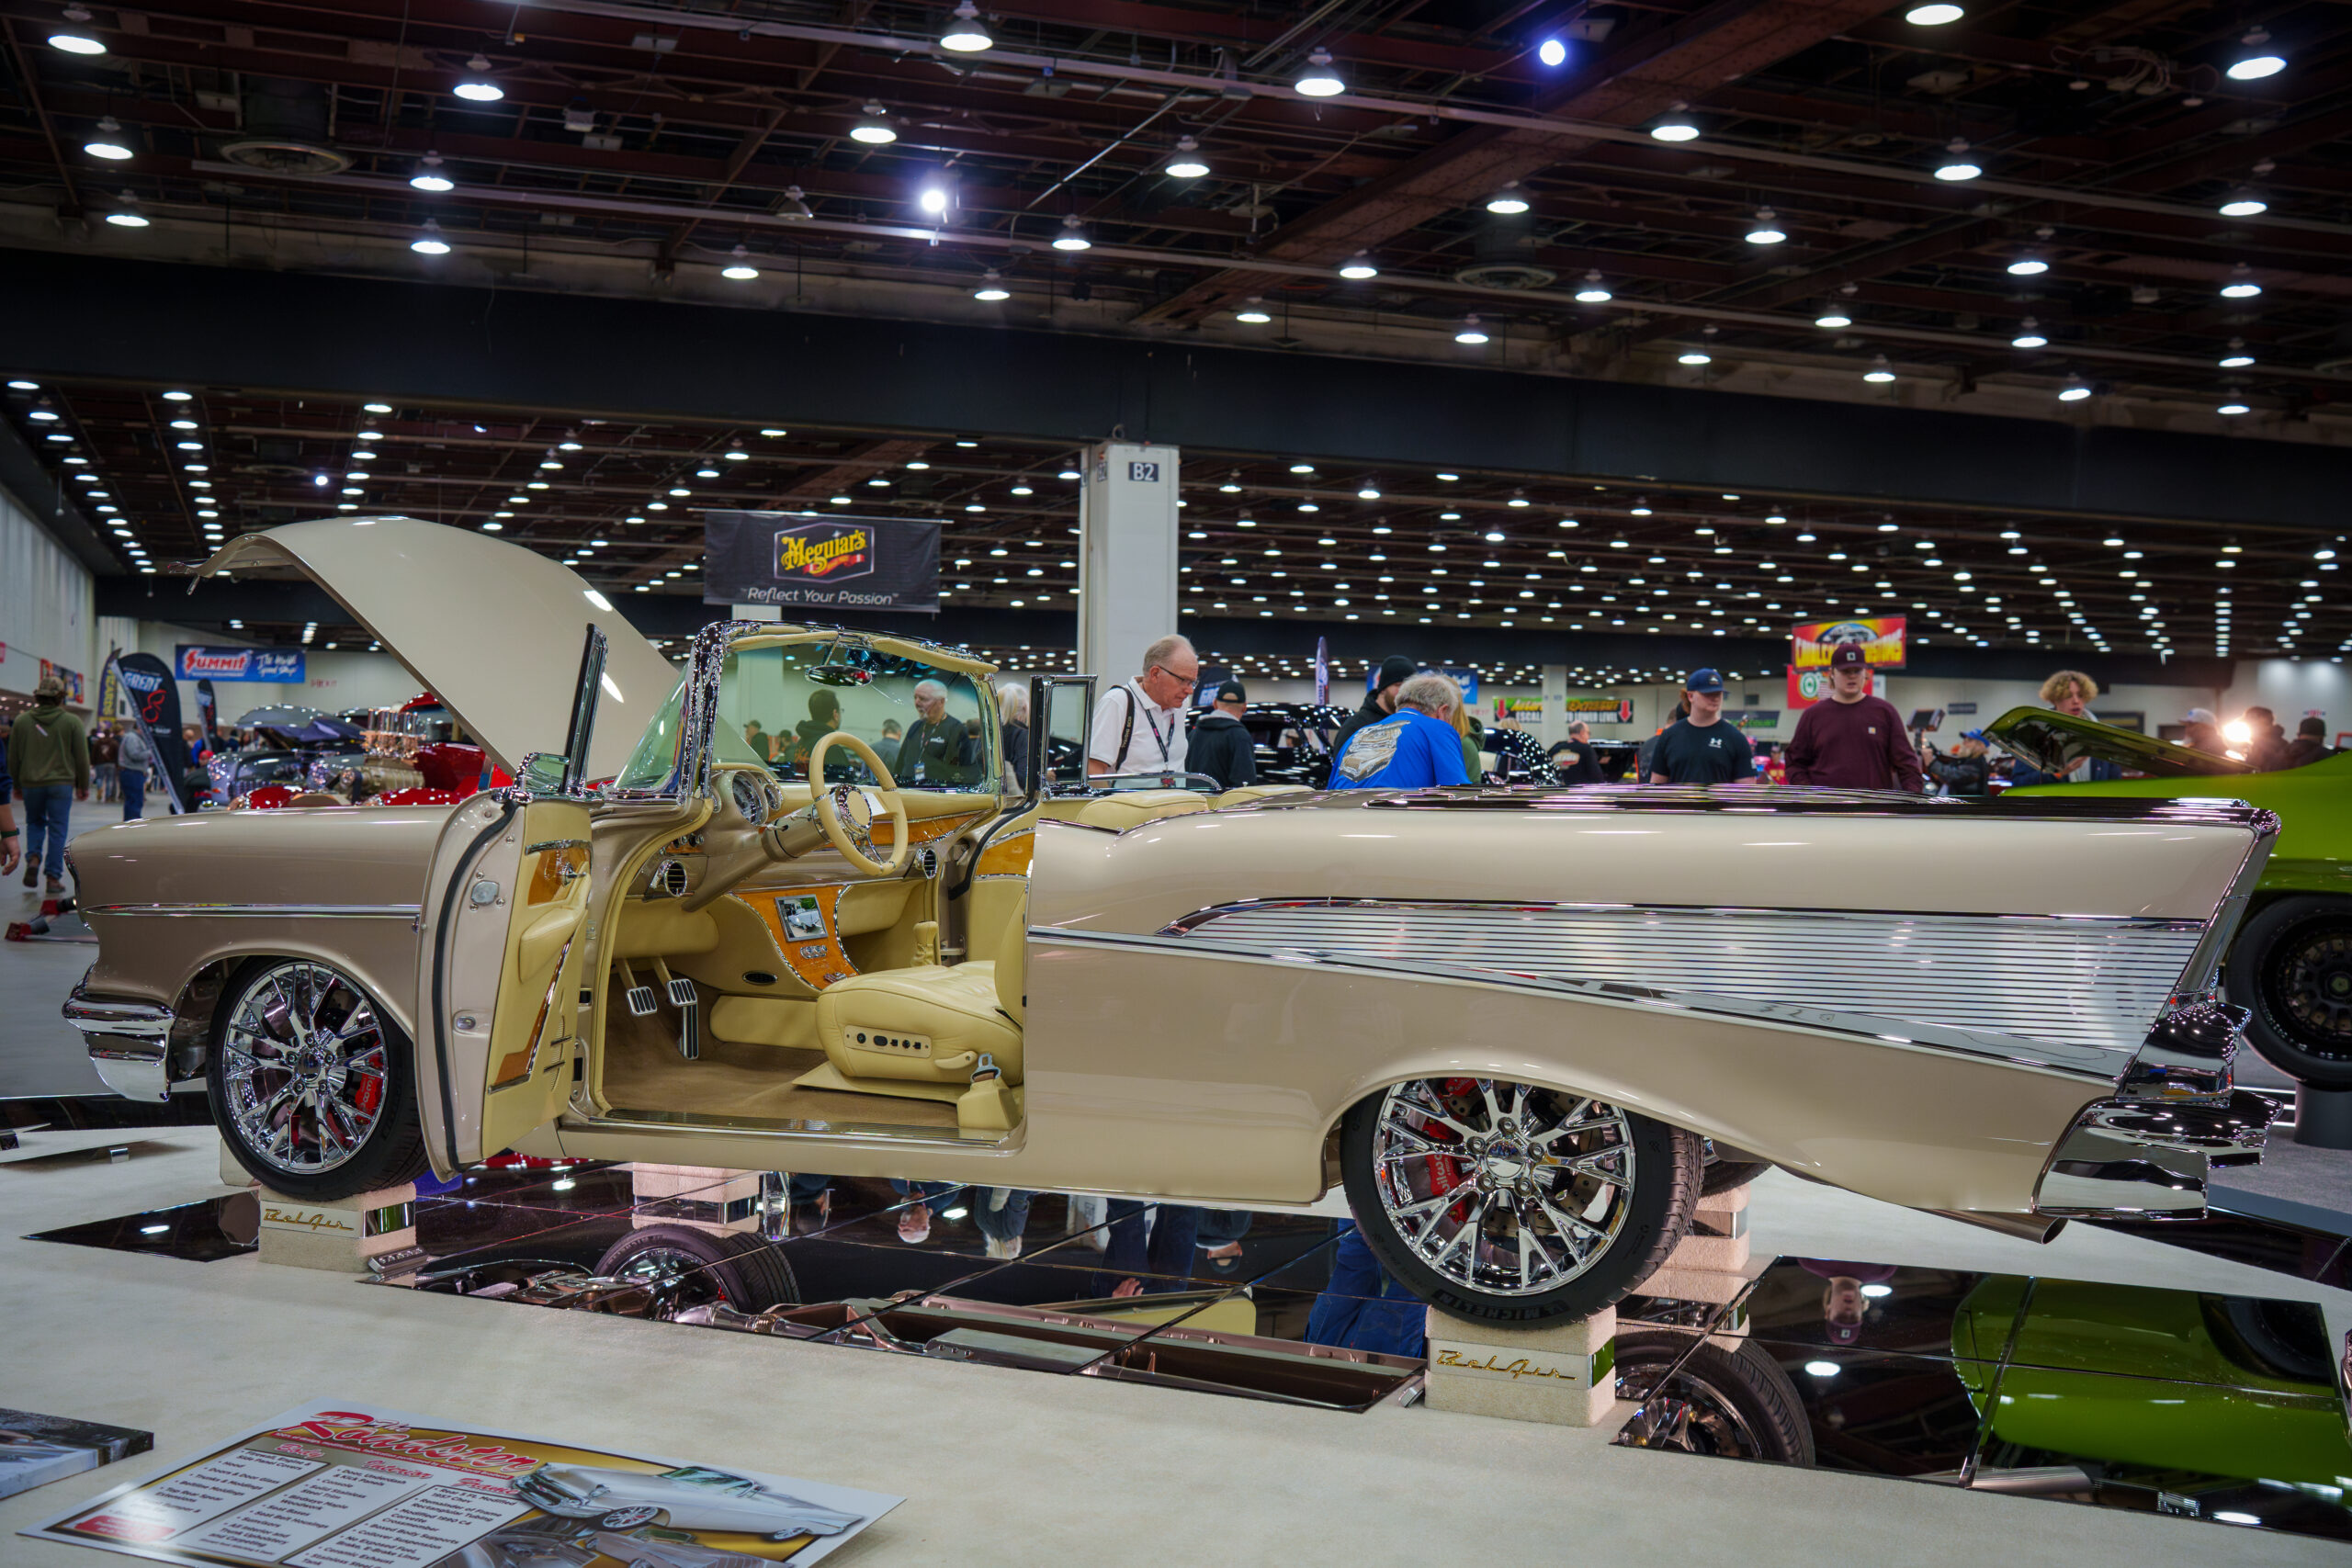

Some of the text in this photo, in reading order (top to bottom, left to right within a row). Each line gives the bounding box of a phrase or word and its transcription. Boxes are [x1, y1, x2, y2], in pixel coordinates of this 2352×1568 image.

[1133, 463, 1155, 481] B2
[781, 529, 867, 575] Meguiar's
[804, 590, 834, 604] Your
[1434, 1153, 1451, 1195] wilwo
[1439, 1292, 1541, 1320] MICHELIN
[1436, 1349, 1577, 1381] Bel Air
[275, 1442, 325, 1460] Body
[277, 1411, 539, 1472] Roadster
[277, 1461, 303, 1470] Covers
[360, 1459, 433, 1479] Interior
[321, 1479, 355, 1488] Console
